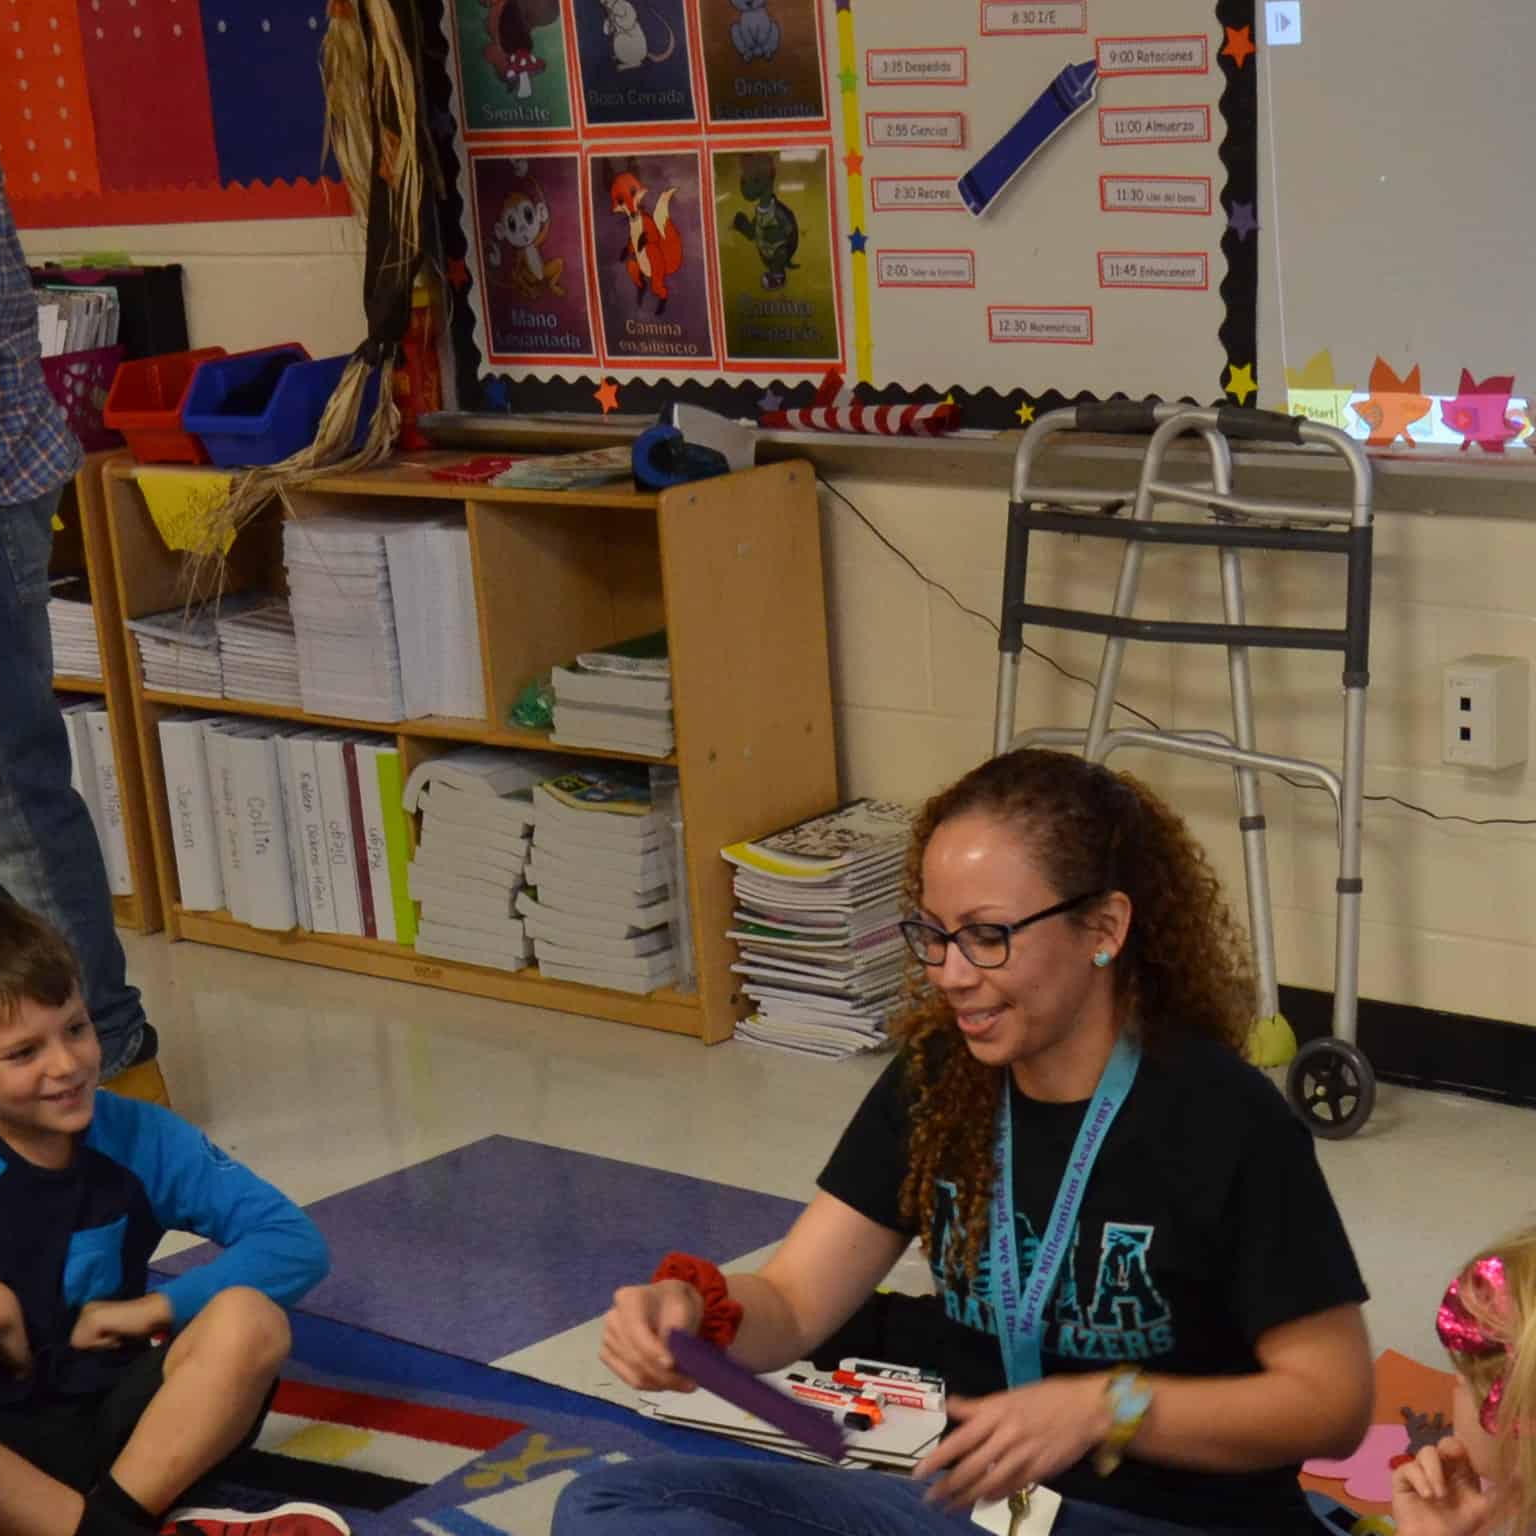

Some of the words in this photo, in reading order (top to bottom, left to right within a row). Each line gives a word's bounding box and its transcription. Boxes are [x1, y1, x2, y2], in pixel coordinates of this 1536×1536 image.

[1109, 49, 1134, 64] 9:00
[1137, 48, 1193, 64] Rotaciones
[1114, 119, 1143, 134] 11:00
[1145, 118, 1195, 134] Almuerzo
[918, 186, 951, 200] Recreo
[887, 263, 909, 277] 2:00
[1109, 263, 1137, 278] 11:45
[511, 308, 558, 329] Mano
[625, 318, 682, 337] Camina
[998, 319, 1027, 333] 12:30
[640, 337, 698, 356] silencio
[1308, 405, 1335, 419] Start
[246, 796, 271, 856] Collin
[328, 819, 347, 867] Diego
[1020, 1287, 1044, 1336] Martin
[1042, 1177, 1081, 1276] Millennium
[1072, 1096, 1116, 1174] Academy
[998, 1232, 1010, 1265] we
[1000, 1269, 1017, 1310] will
